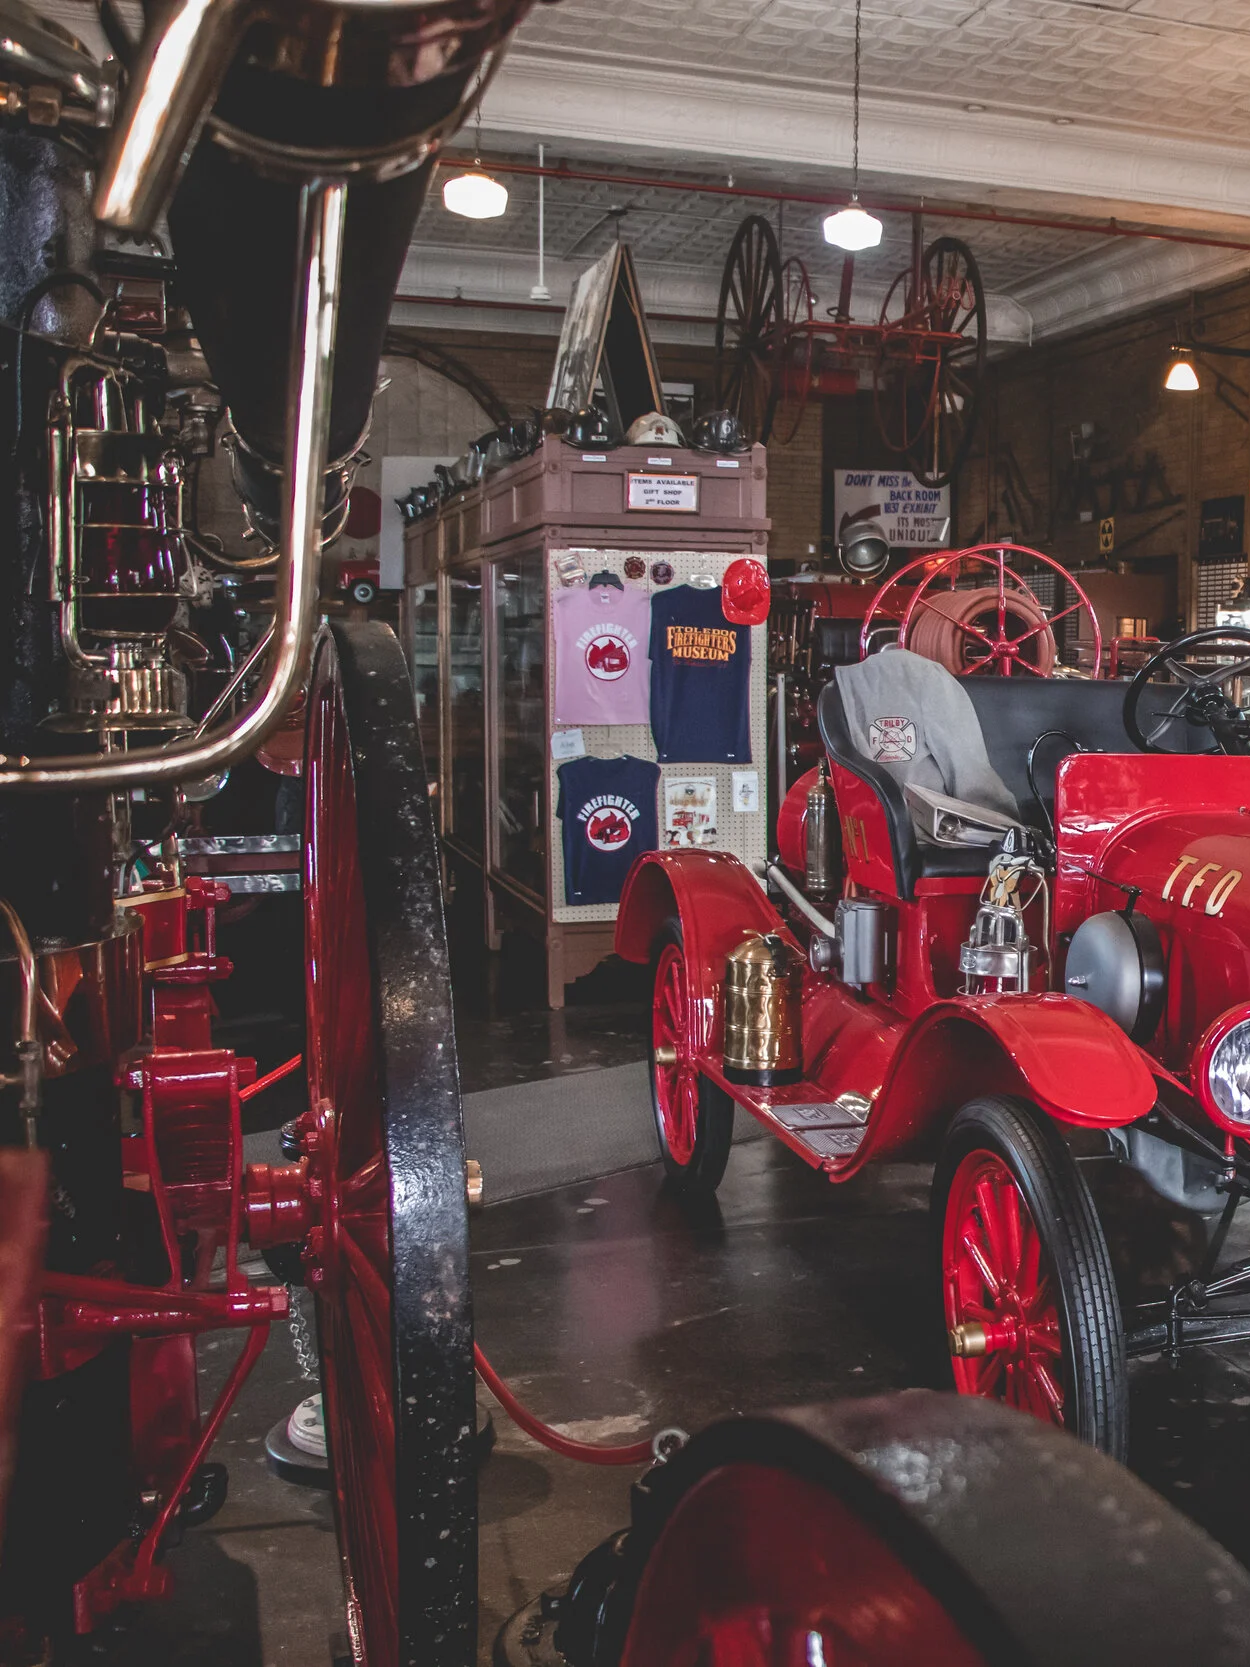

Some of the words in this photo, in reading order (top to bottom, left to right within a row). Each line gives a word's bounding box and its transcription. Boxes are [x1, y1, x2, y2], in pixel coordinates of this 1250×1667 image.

[656, 479, 695, 487] AVAILABLE
[877, 475, 899, 487] MISS
[889, 490, 912, 501] BACK
[915, 490, 941, 501] ROOM
[902, 503, 939, 515] EXHIBIT
[575, 623, 638, 650] FIREFIGHTER
[675, 625, 729, 637] TOLEDO
[666, 625, 737, 655] FIREFIGHTERS
[672, 646, 729, 662] MUSEUM
[879, 719, 905, 728] TRILBY
[872, 736, 878, 745] F
[576, 794, 641, 822] FIREFIGHTER
